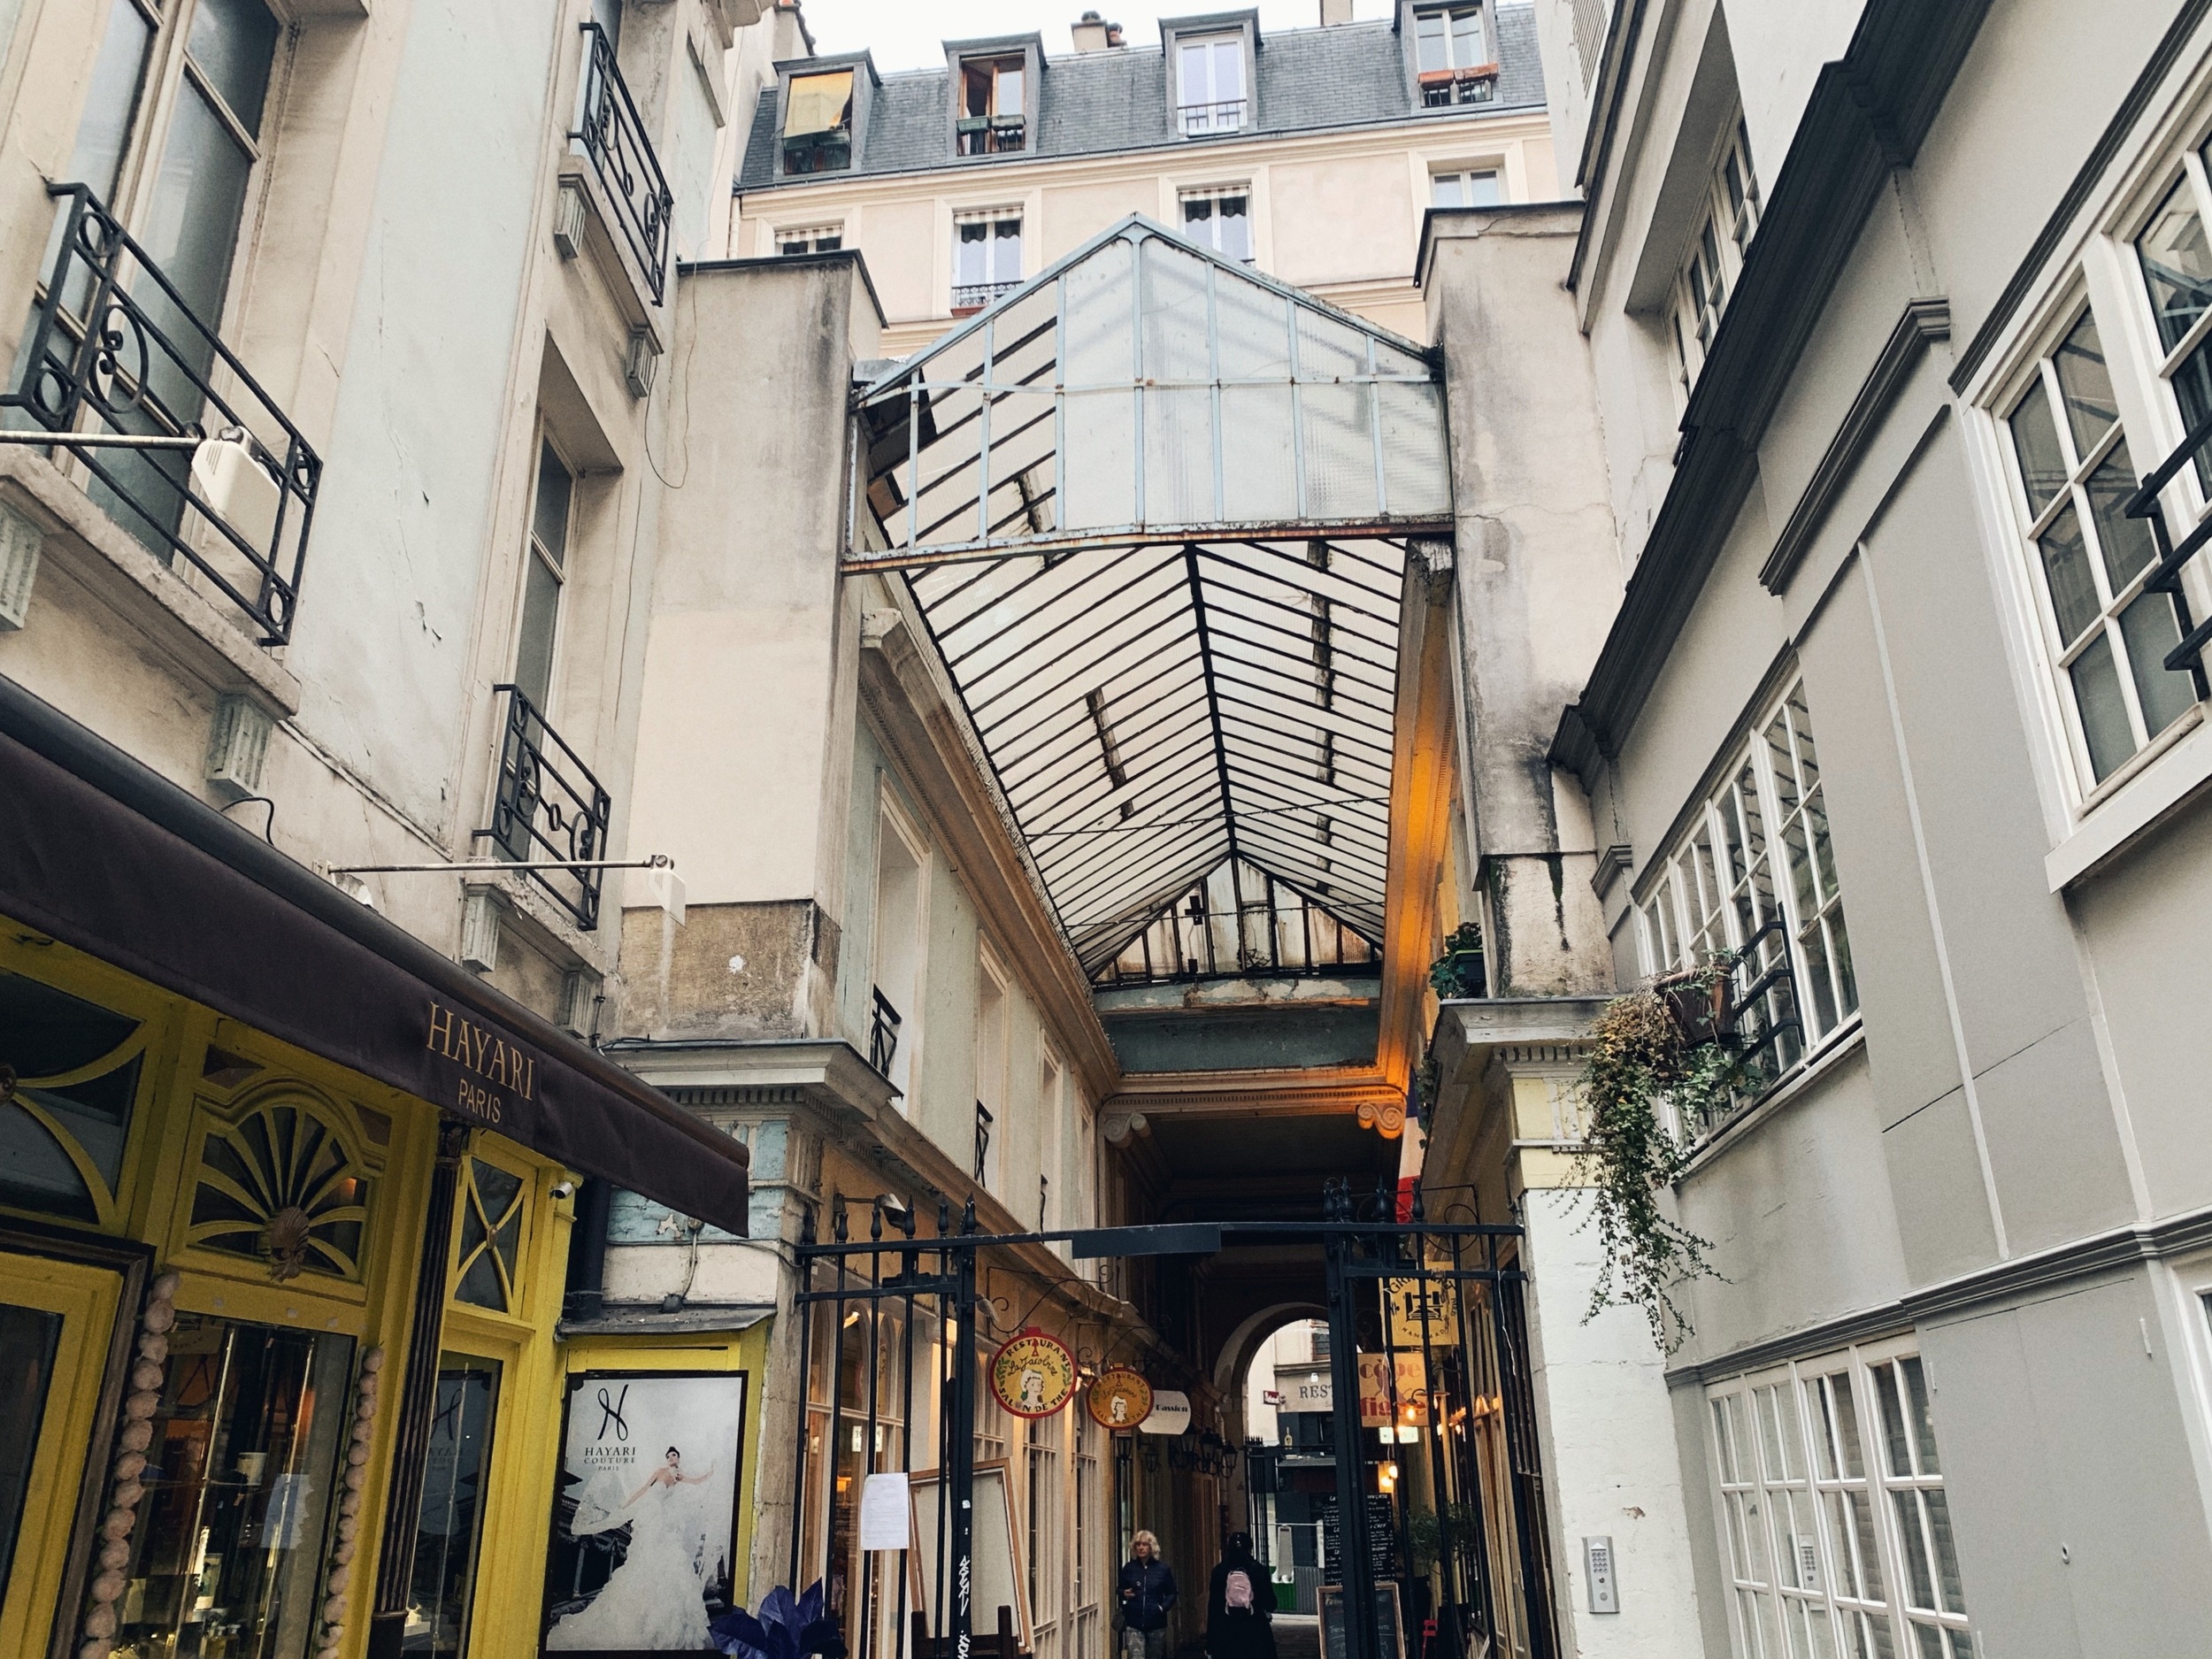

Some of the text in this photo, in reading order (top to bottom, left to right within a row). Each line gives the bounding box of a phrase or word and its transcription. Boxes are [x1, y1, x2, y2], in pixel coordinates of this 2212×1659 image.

[426, 1001, 534, 1101] HAYARI
[458, 1079, 501, 1123] PARIS
[1007, 1355, 1057, 1377] La Jacobine
[1299, 1385, 1332, 1399] RES
[585, 1447, 636, 1456] HAYARI
